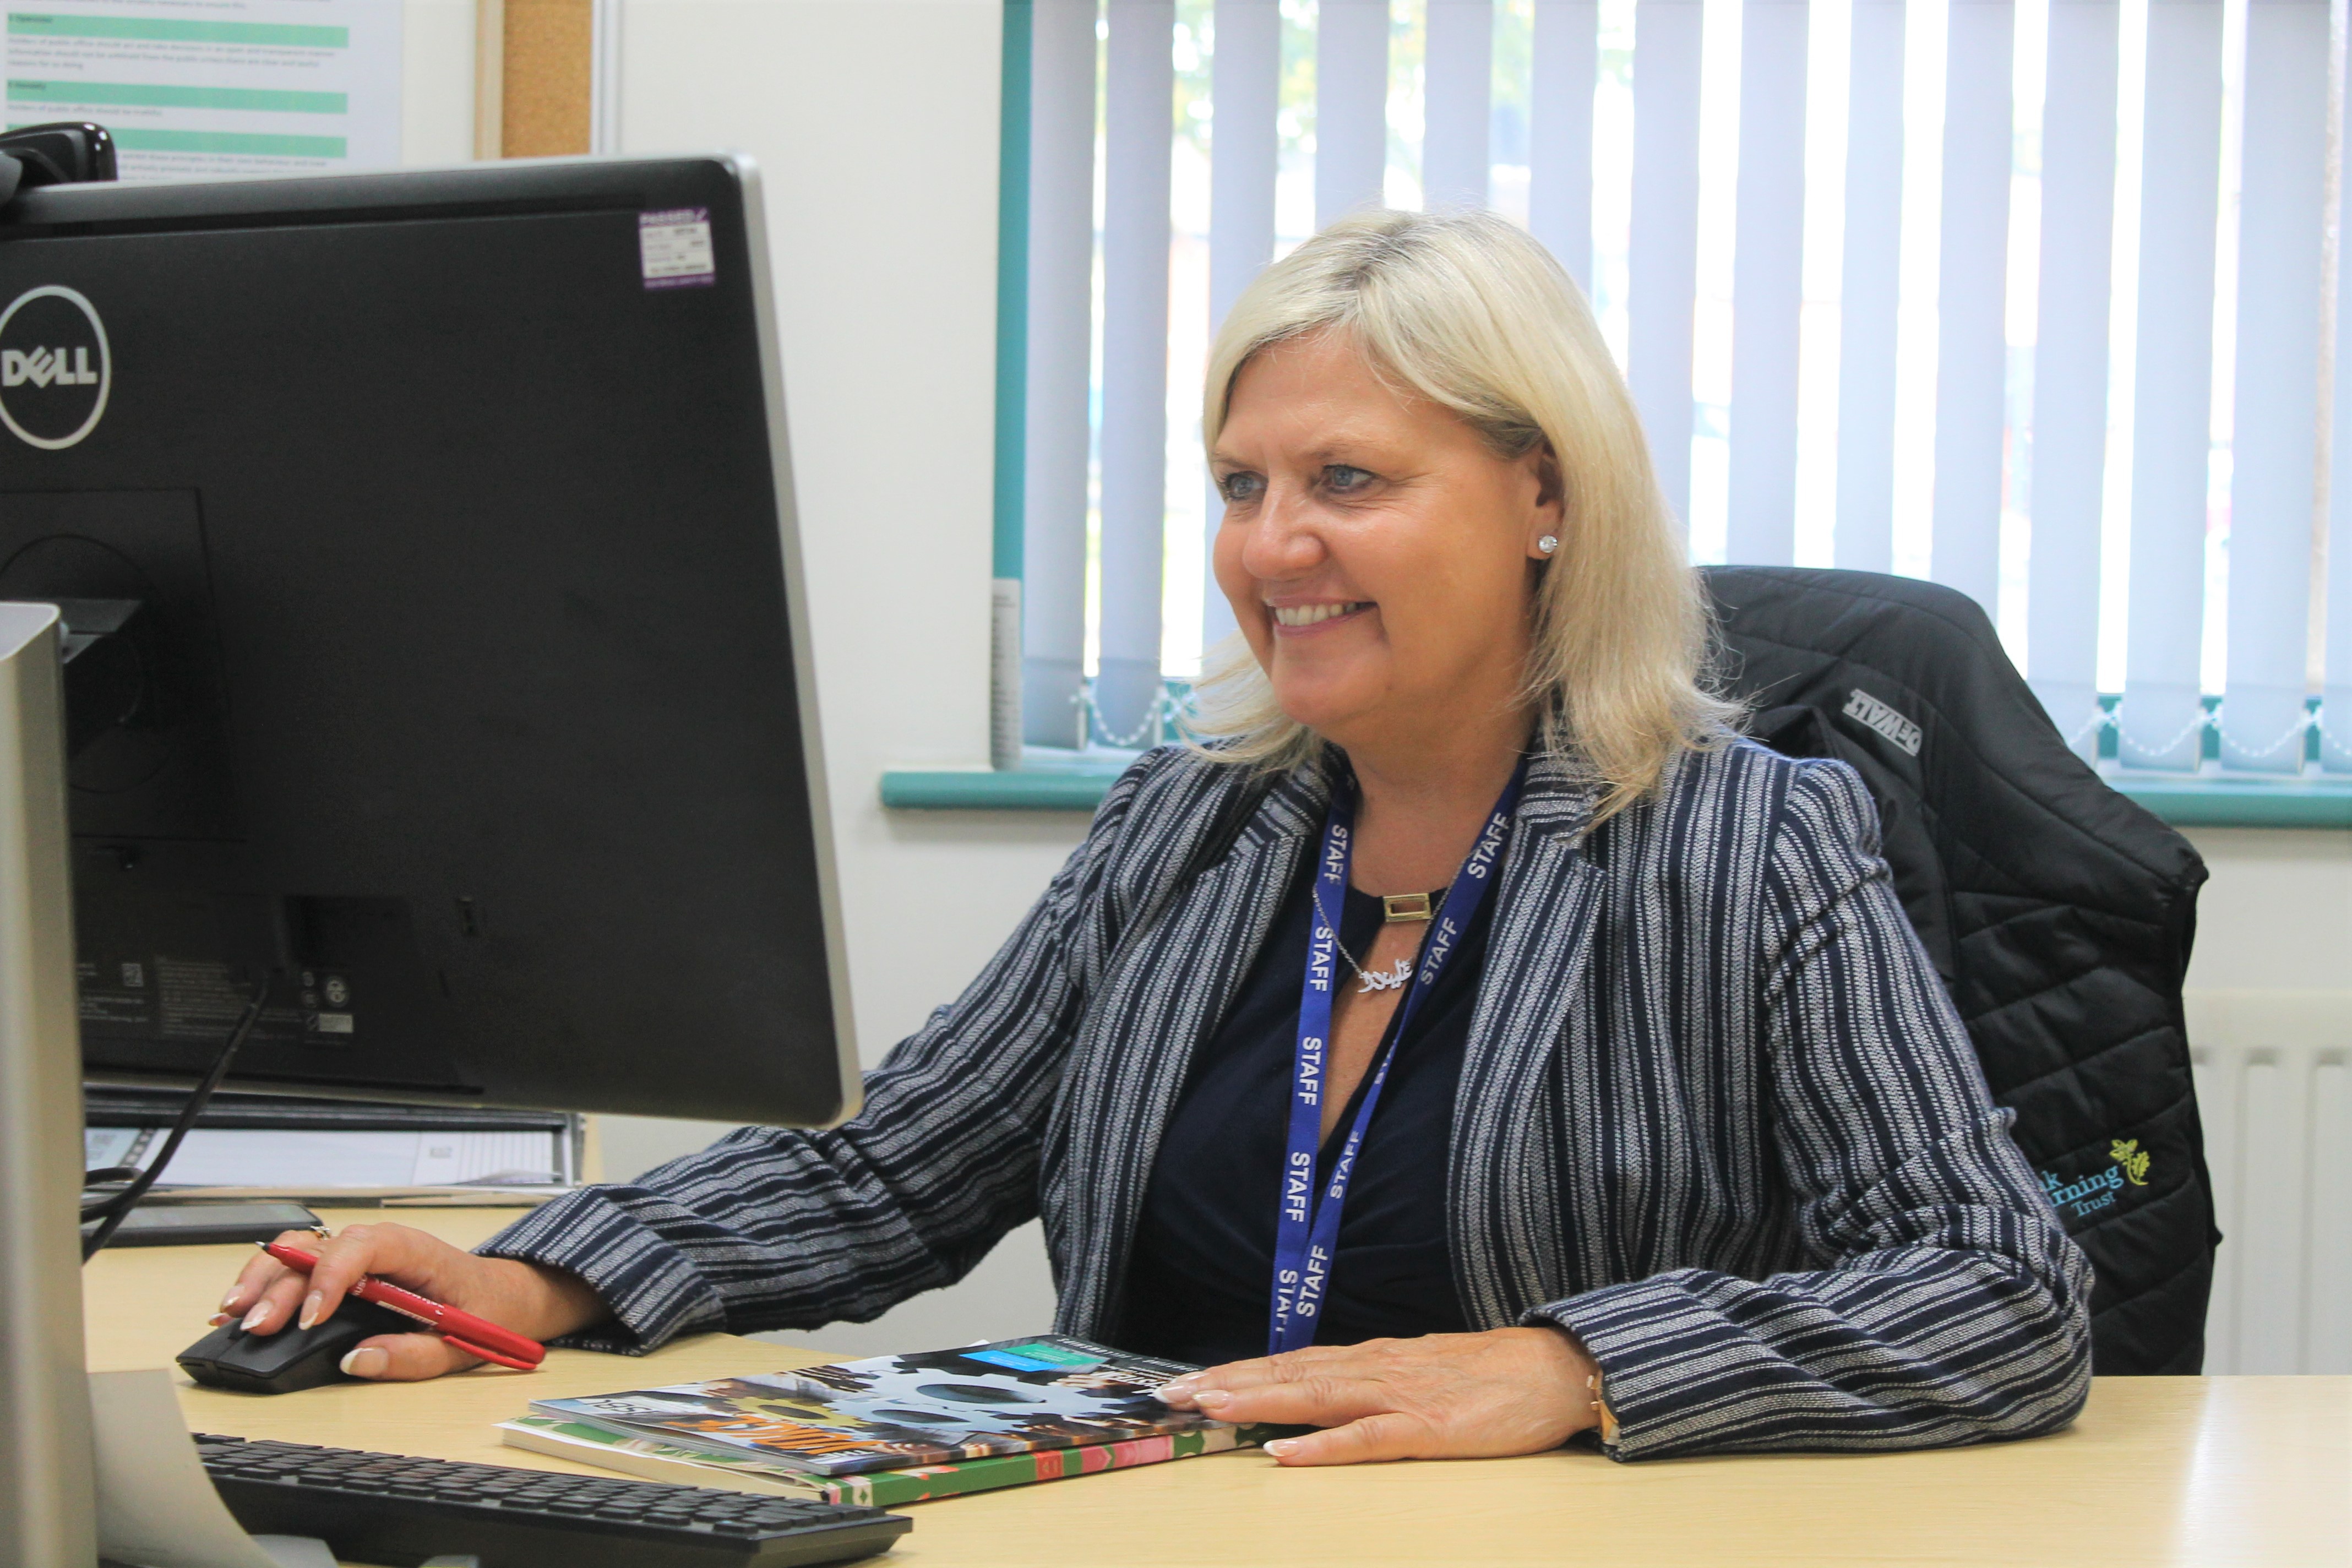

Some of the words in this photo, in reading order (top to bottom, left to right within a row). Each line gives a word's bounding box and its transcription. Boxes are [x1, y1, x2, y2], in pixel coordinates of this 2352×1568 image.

[1, 345, 97, 389] DELL
[1843, 689, 1923, 756] DEWALT
[1324, 824, 1348, 886] STAFF
[1467, 812, 1511, 879] STAFF
[1309, 926, 1333, 992] STAFF
[1420, 917, 1458, 986] STAFF
[1298, 1037, 1322, 1106] STAFF
[1285, 1152, 1310, 1223] STAFF
[1330, 1130, 1360, 1199] STAFF
[2070, 1191, 2117, 1217] Trust
[1296, 1245, 1329, 1317] STAFF
[662, 1415, 885, 1455] VOICE
[817, 1449, 875, 1458] THE
